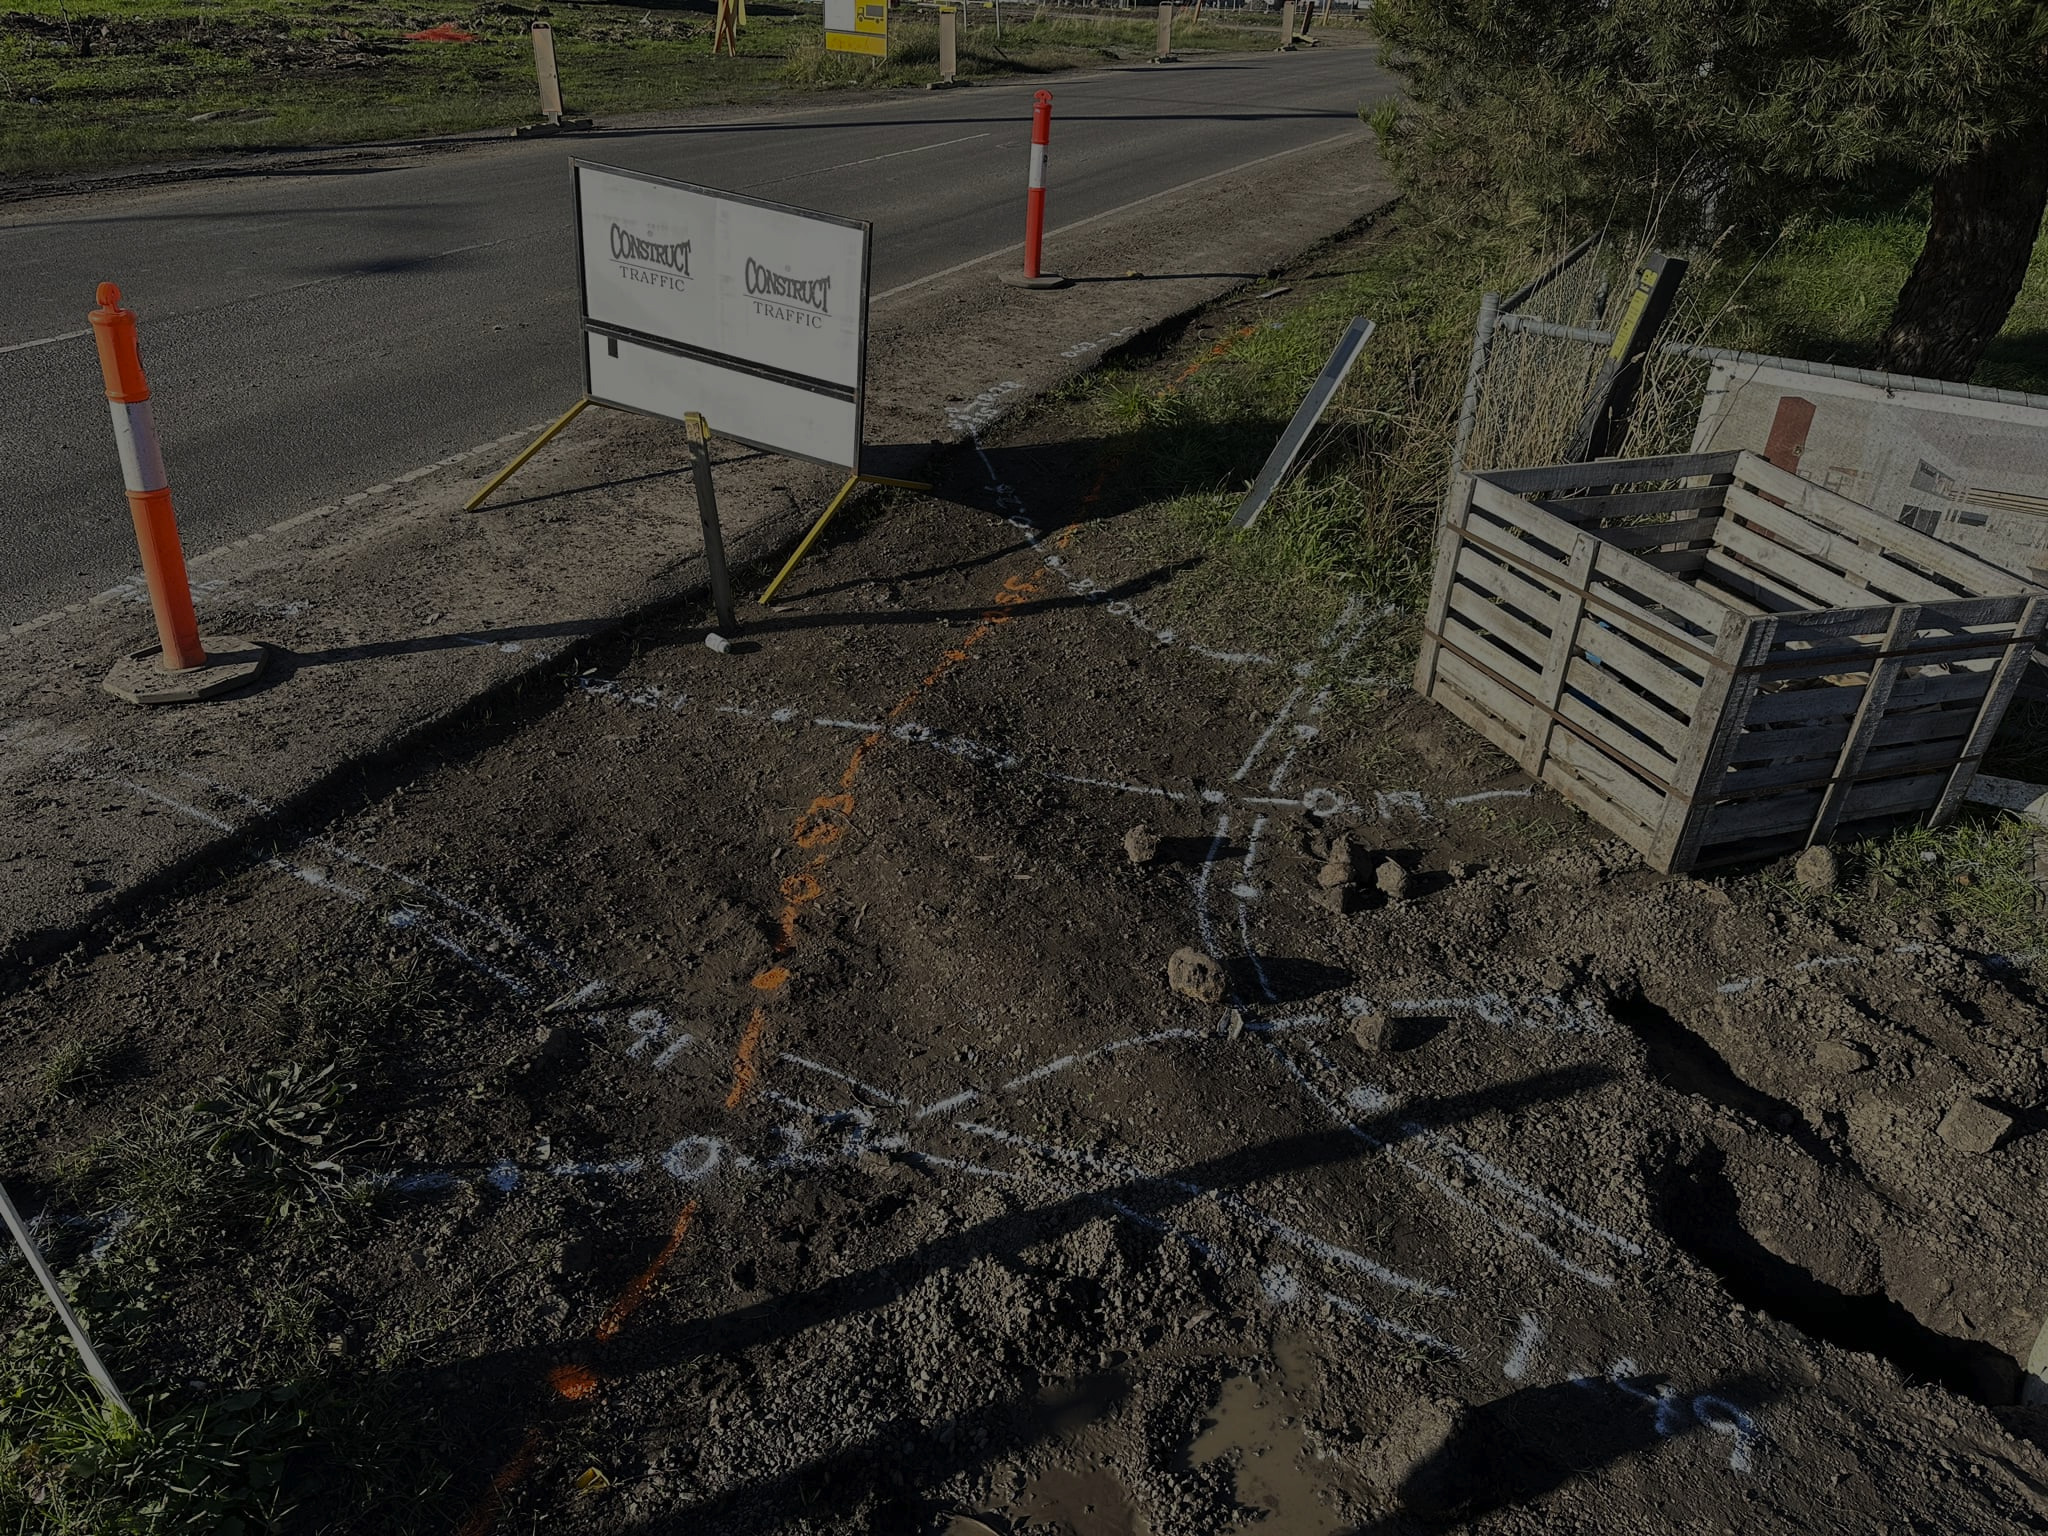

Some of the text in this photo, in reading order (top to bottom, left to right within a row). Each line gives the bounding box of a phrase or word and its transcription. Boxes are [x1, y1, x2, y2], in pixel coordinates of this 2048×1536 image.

[610, 222, 691, 277] CONSTRUCT
[619, 265, 686, 292] TRAFFIC
[745, 256, 831, 312] CONSTRUCT
[753, 301, 823, 329] TRAFFIC
